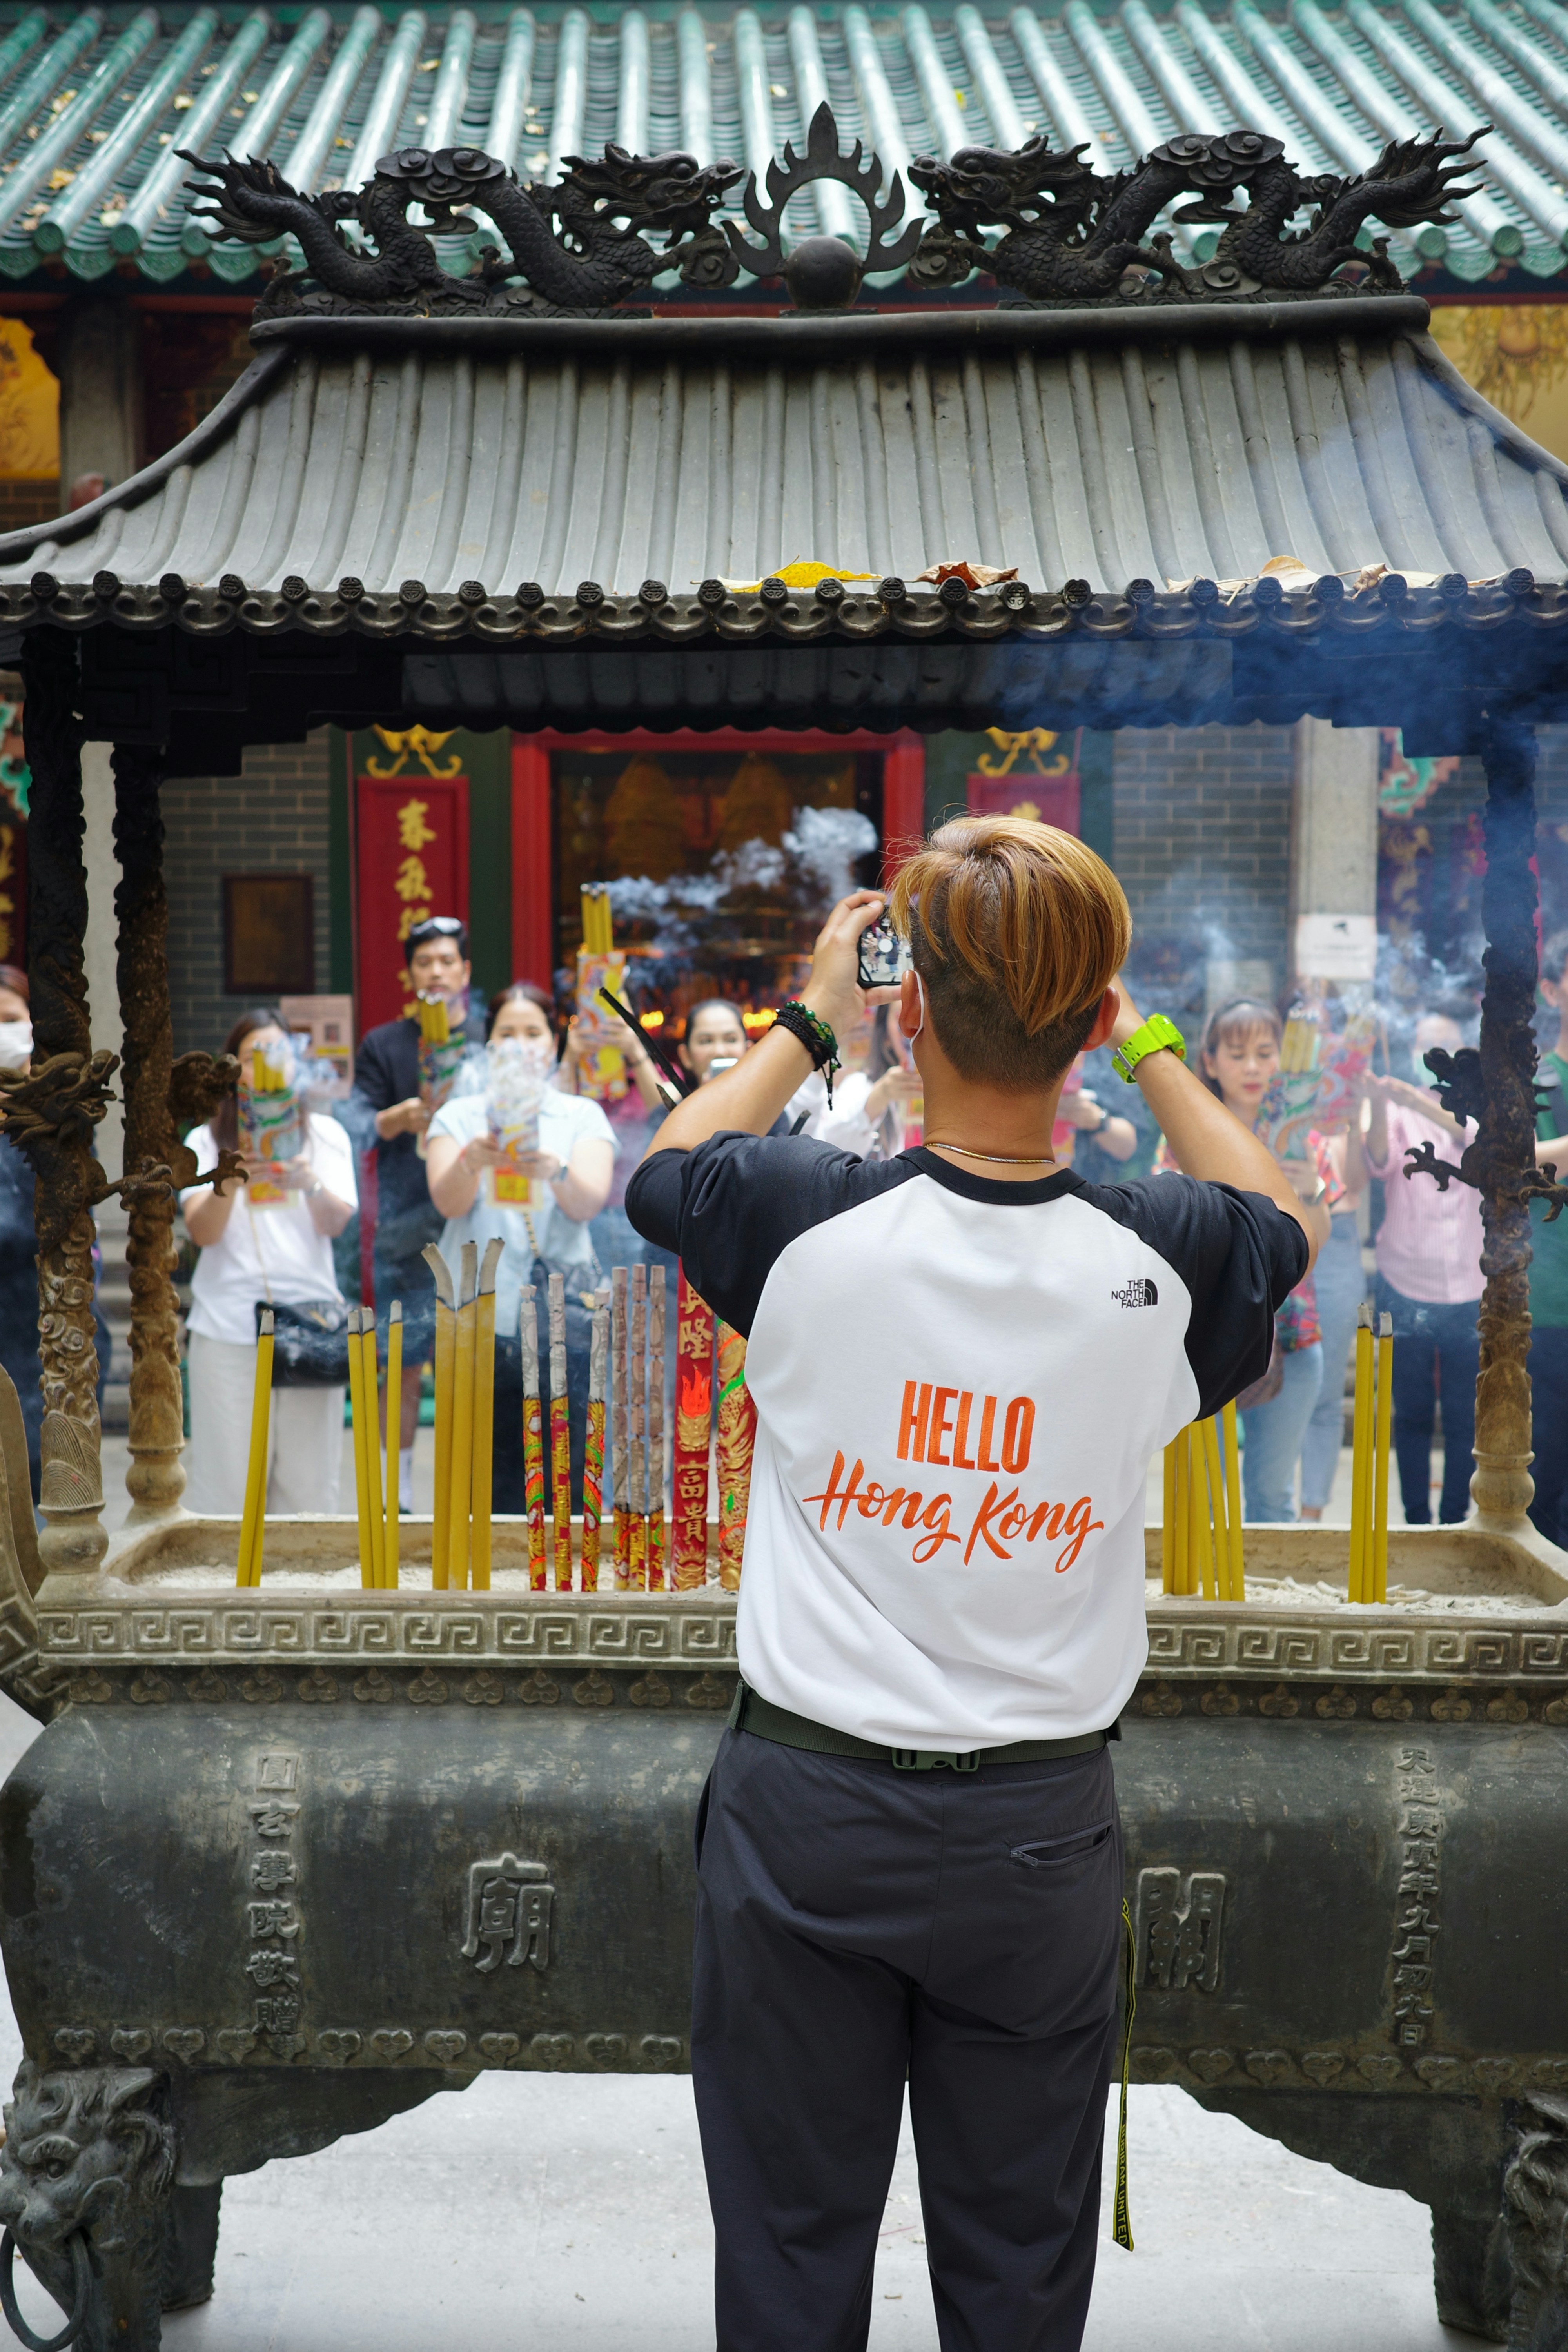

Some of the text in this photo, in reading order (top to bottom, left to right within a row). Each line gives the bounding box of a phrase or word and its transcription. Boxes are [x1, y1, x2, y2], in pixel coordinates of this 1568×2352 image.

[1111, 1288, 1144, 1300] NORTH
[1122, 1298, 1143, 1309] FACE
[1127, 1279, 1144, 1289] THE
[896, 1380, 1036, 1474] HELLO
[677, 1460, 709, 1544] 富貴
[802, 1450, 1105, 1573] Hong Kong
[1118, 2189, 1128, 2245] UNITED
